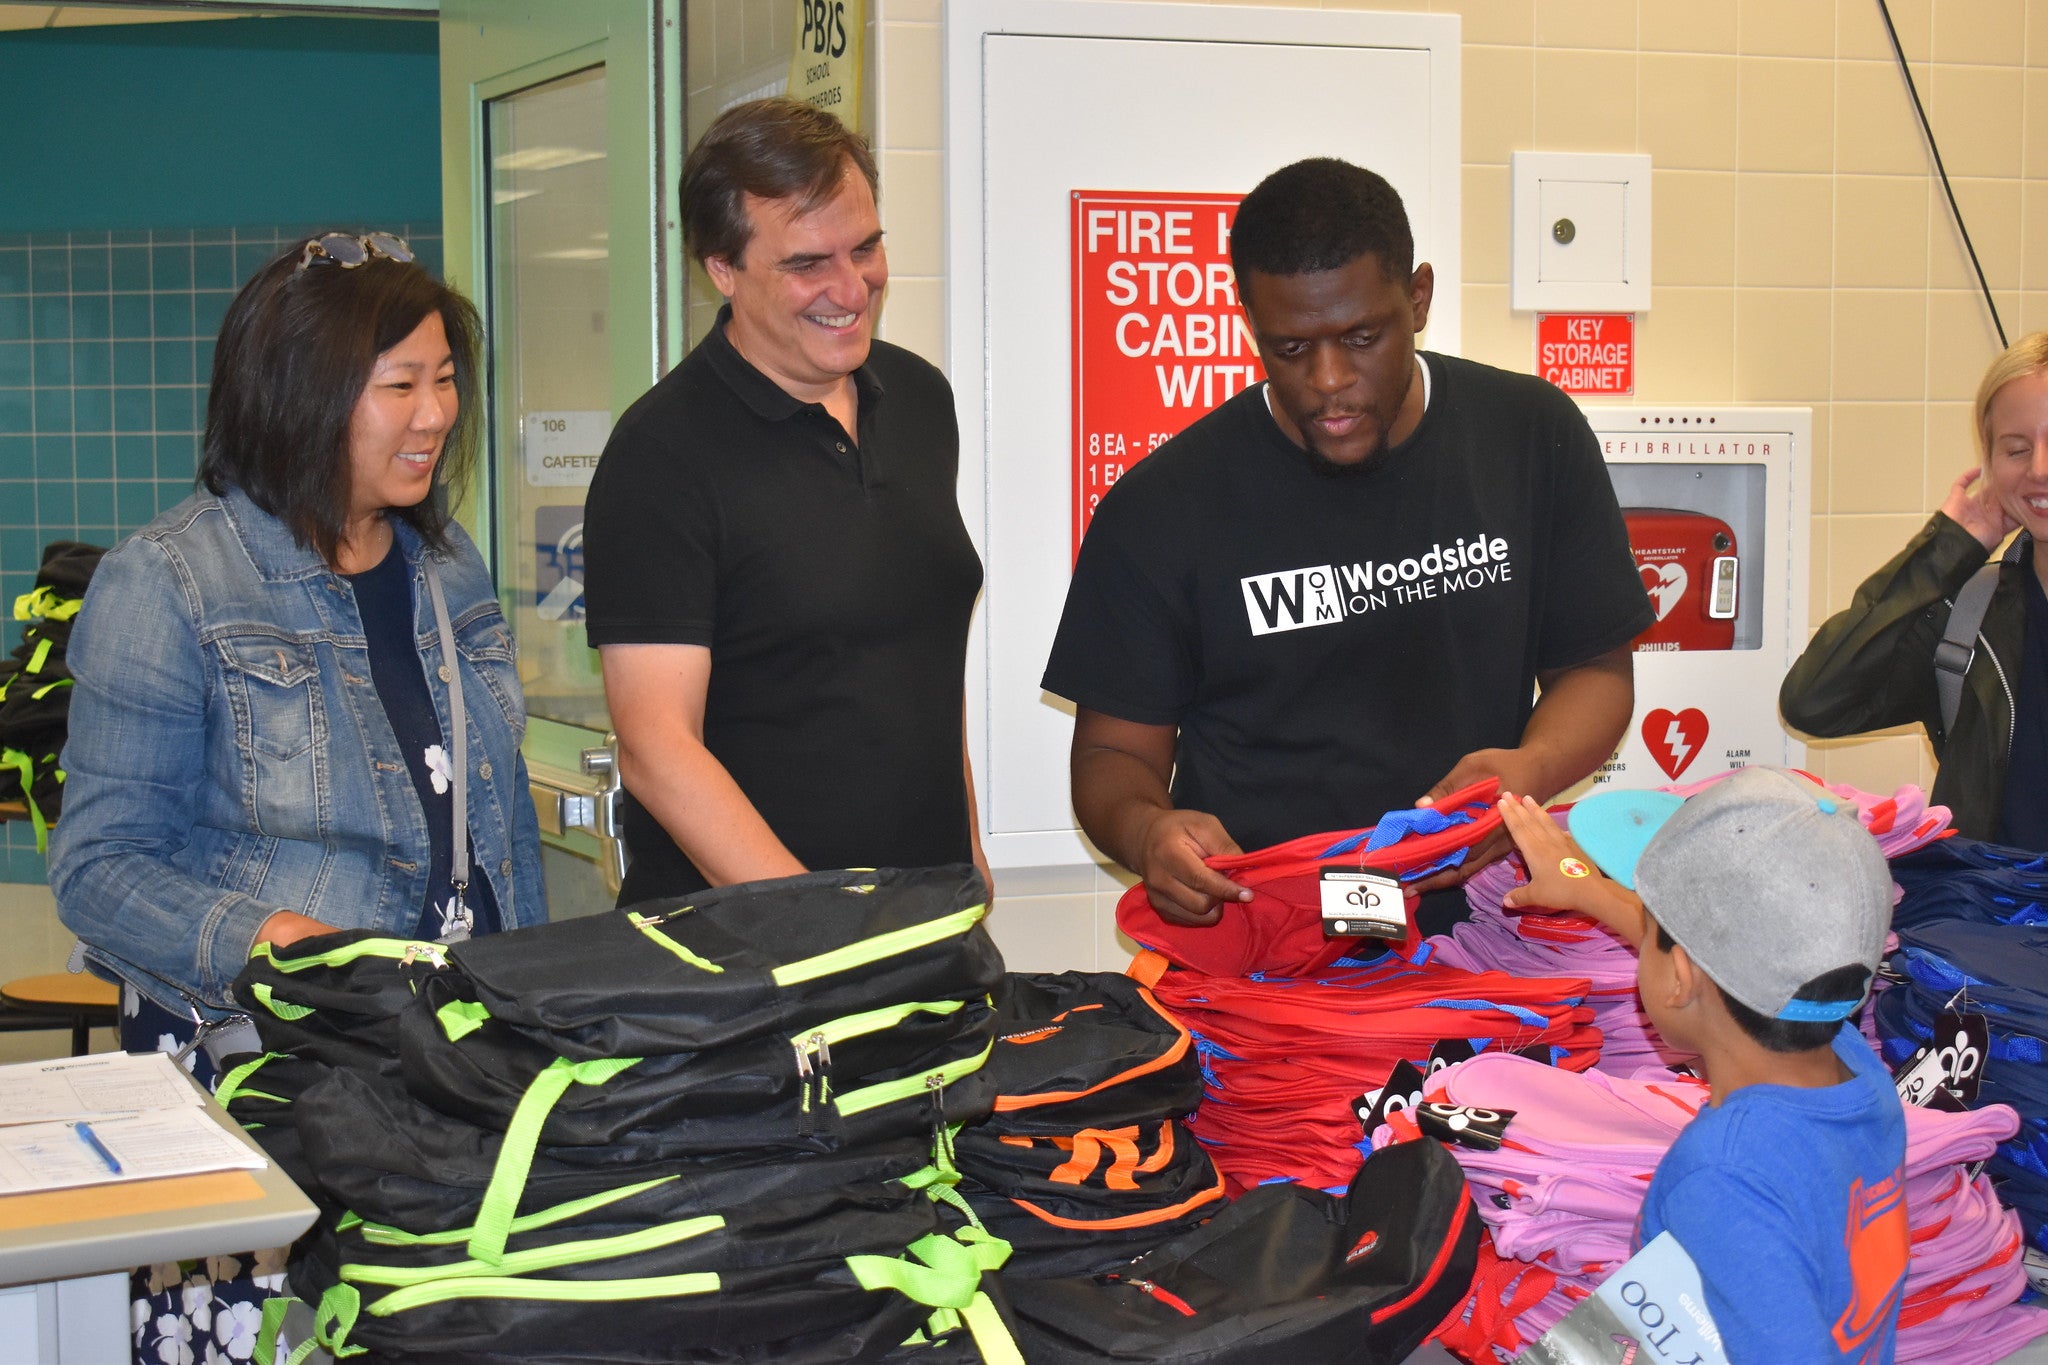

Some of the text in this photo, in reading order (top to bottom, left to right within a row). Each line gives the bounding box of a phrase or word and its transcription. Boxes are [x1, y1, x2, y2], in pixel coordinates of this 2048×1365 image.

[802, 0, 846, 58] PBIS
[806, 62, 830, 85] SCHOOL
[1088, 210, 1194, 255] FIRE
[1106, 261, 1243, 306] STOR
[1567, 319, 1603, 340] KEY
[1543, 343, 1628, 365] STORAGE
[1546, 367, 1624, 389] CABINET
[543, 420, 566, 432] 106
[1089, 433, 1100, 456] 8
[1104, 433, 1126, 456] EA
[543, 455, 601, 469] CAFETE
[1089, 464, 1097, 486] 1
[1341, 533, 1509, 593] Woodside
[1349, 562, 1512, 615] ON THE MOVE
[1249, 573, 1304, 629] W
[1638, 642, 1680, 652] PHILIPS
[1726, 749, 1750, 758] ALARM
[1593, 775, 1611, 783] ONLY
[1621, 1280, 1681, 1356] TOO
